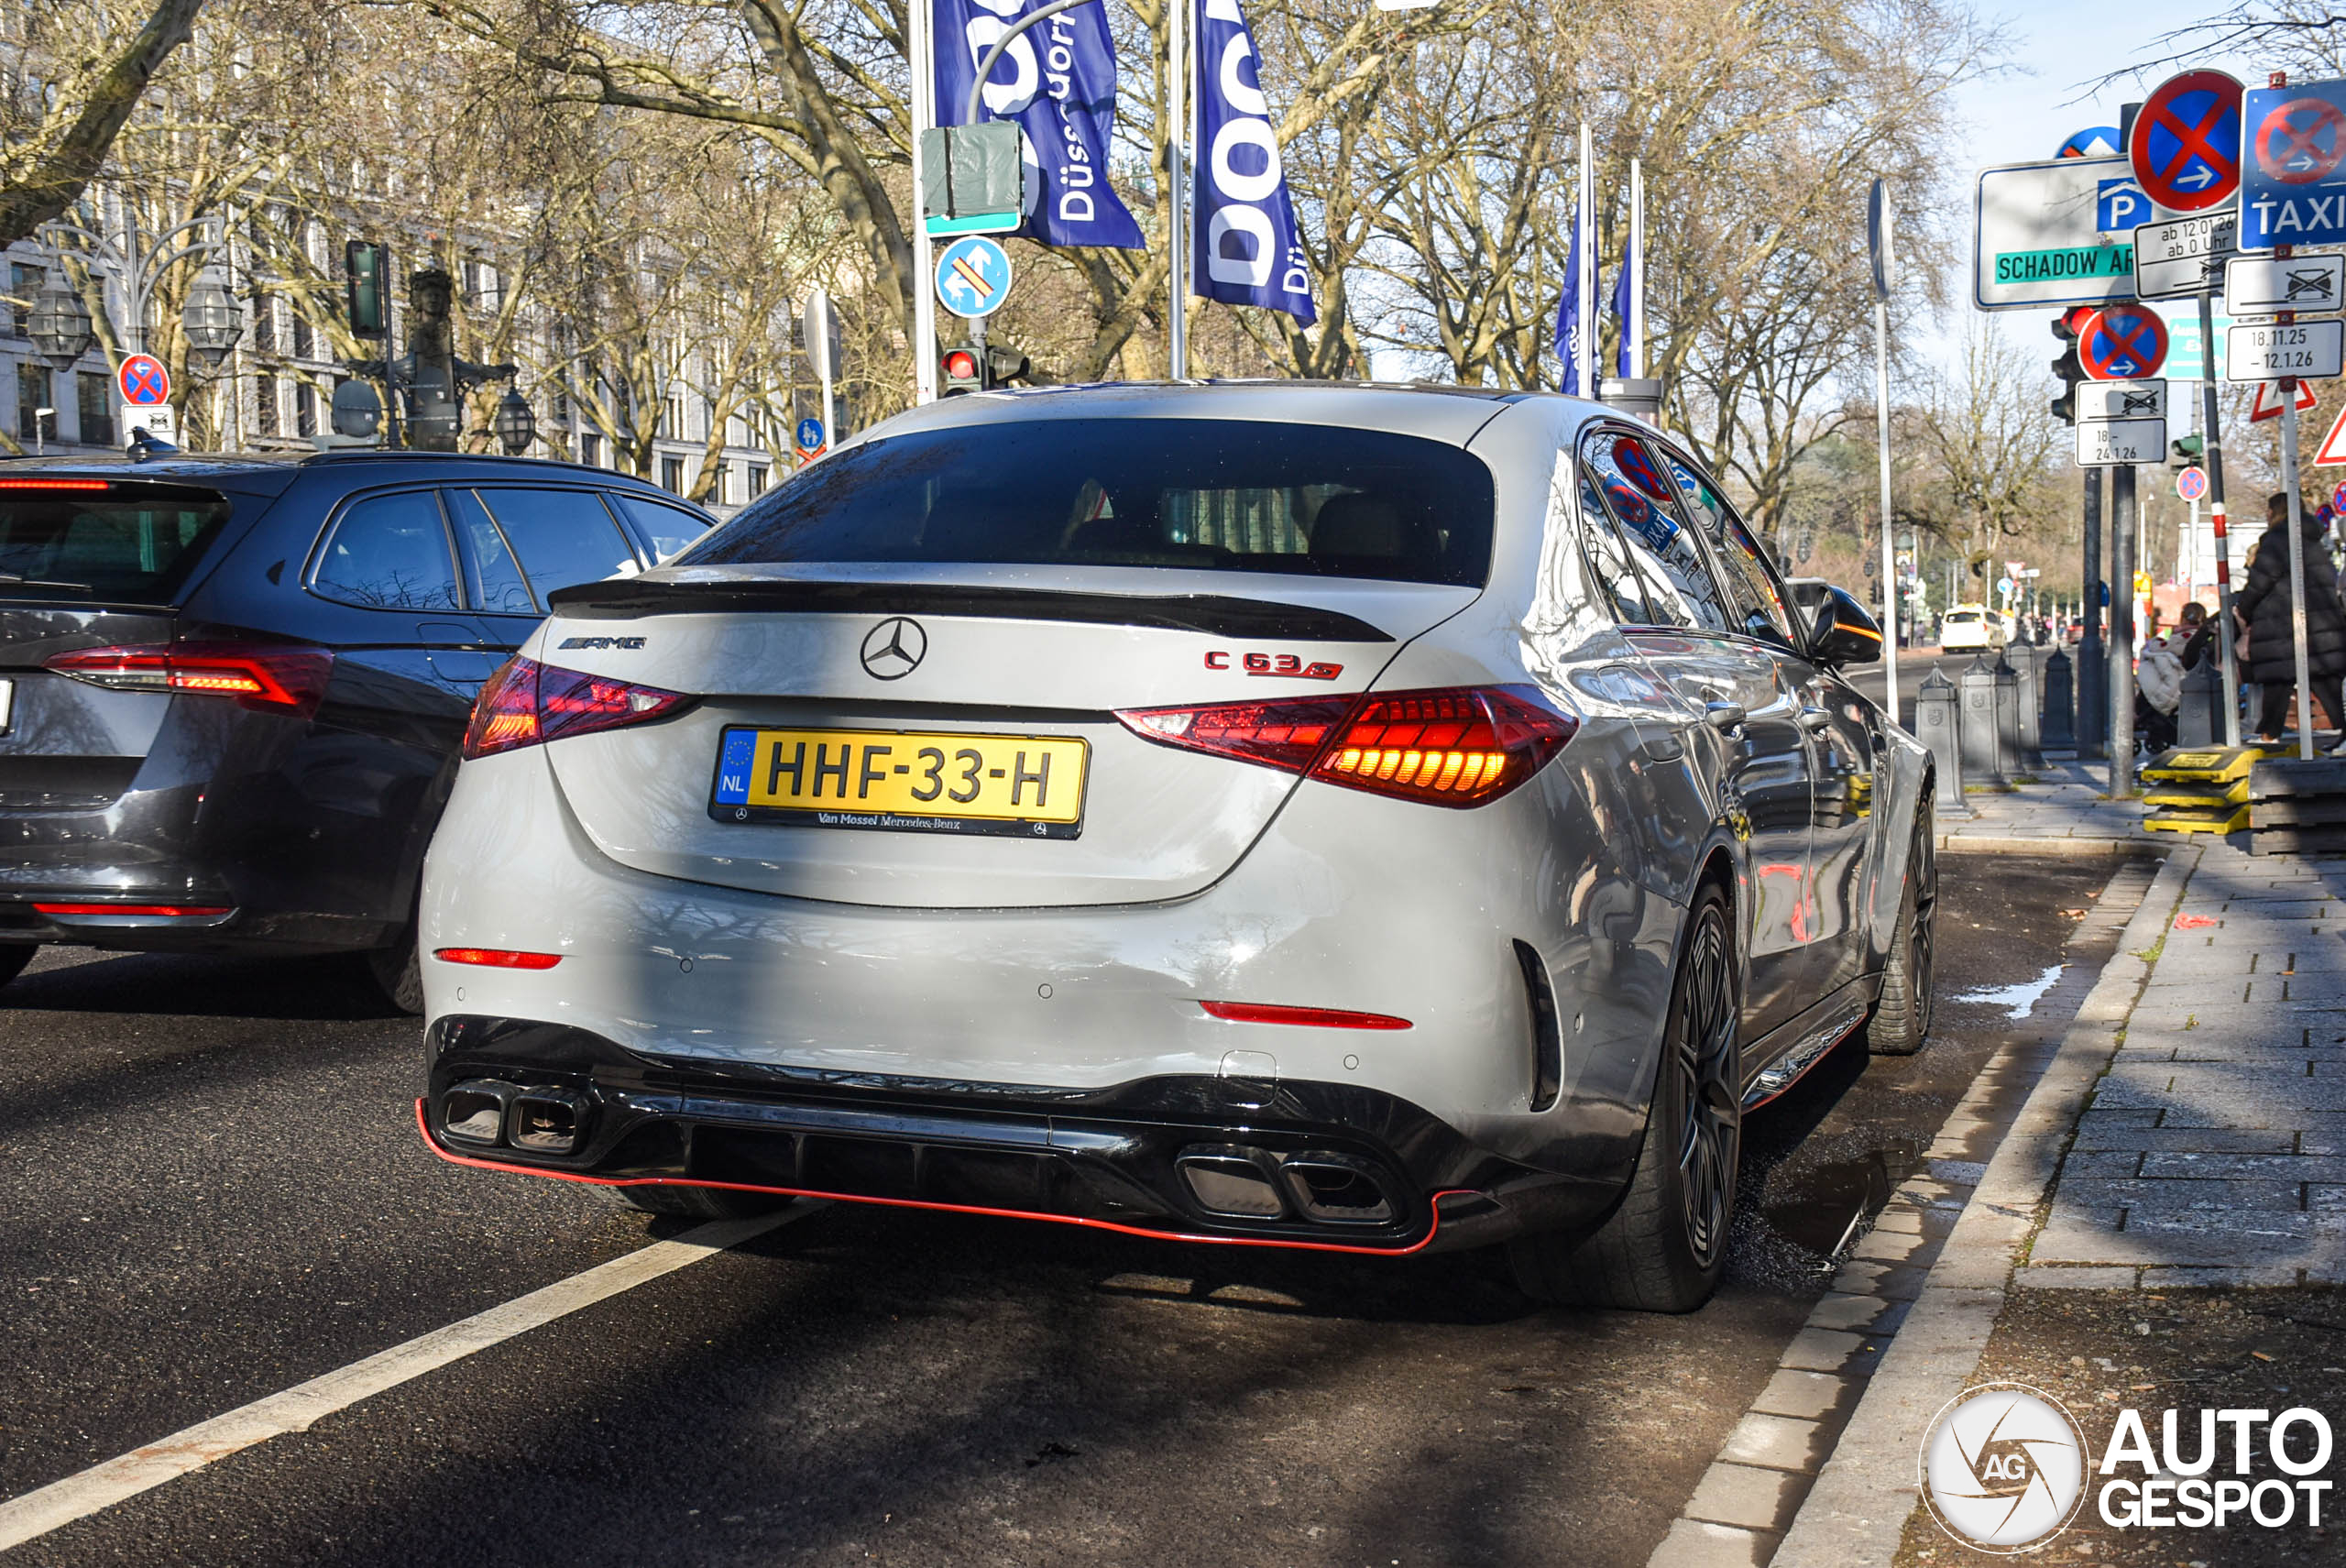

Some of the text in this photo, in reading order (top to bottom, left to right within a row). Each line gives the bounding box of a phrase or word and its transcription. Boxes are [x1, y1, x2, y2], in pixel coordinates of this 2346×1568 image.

[2252, 194, 2346, 236] TAXI
[2162, 215, 2234, 242] ab 12.01.26
[2168, 235, 2229, 257] ab 0 Uhr
[1999, 250, 2098, 280] SCHADOW
[2252, 328, 2308, 346] 18.11.25
[2264, 351, 2313, 368] 12.1.26
[2097, 446, 2137, 461] 24.1.26
[581, 637, 647, 650] AMG
[1204, 651, 1230, 670] C
[767, 741, 1051, 807] HHF-33-H
[722, 775, 744, 792] NL
[817, 812, 960, 830] Van Mossel Mercedes-Benz
